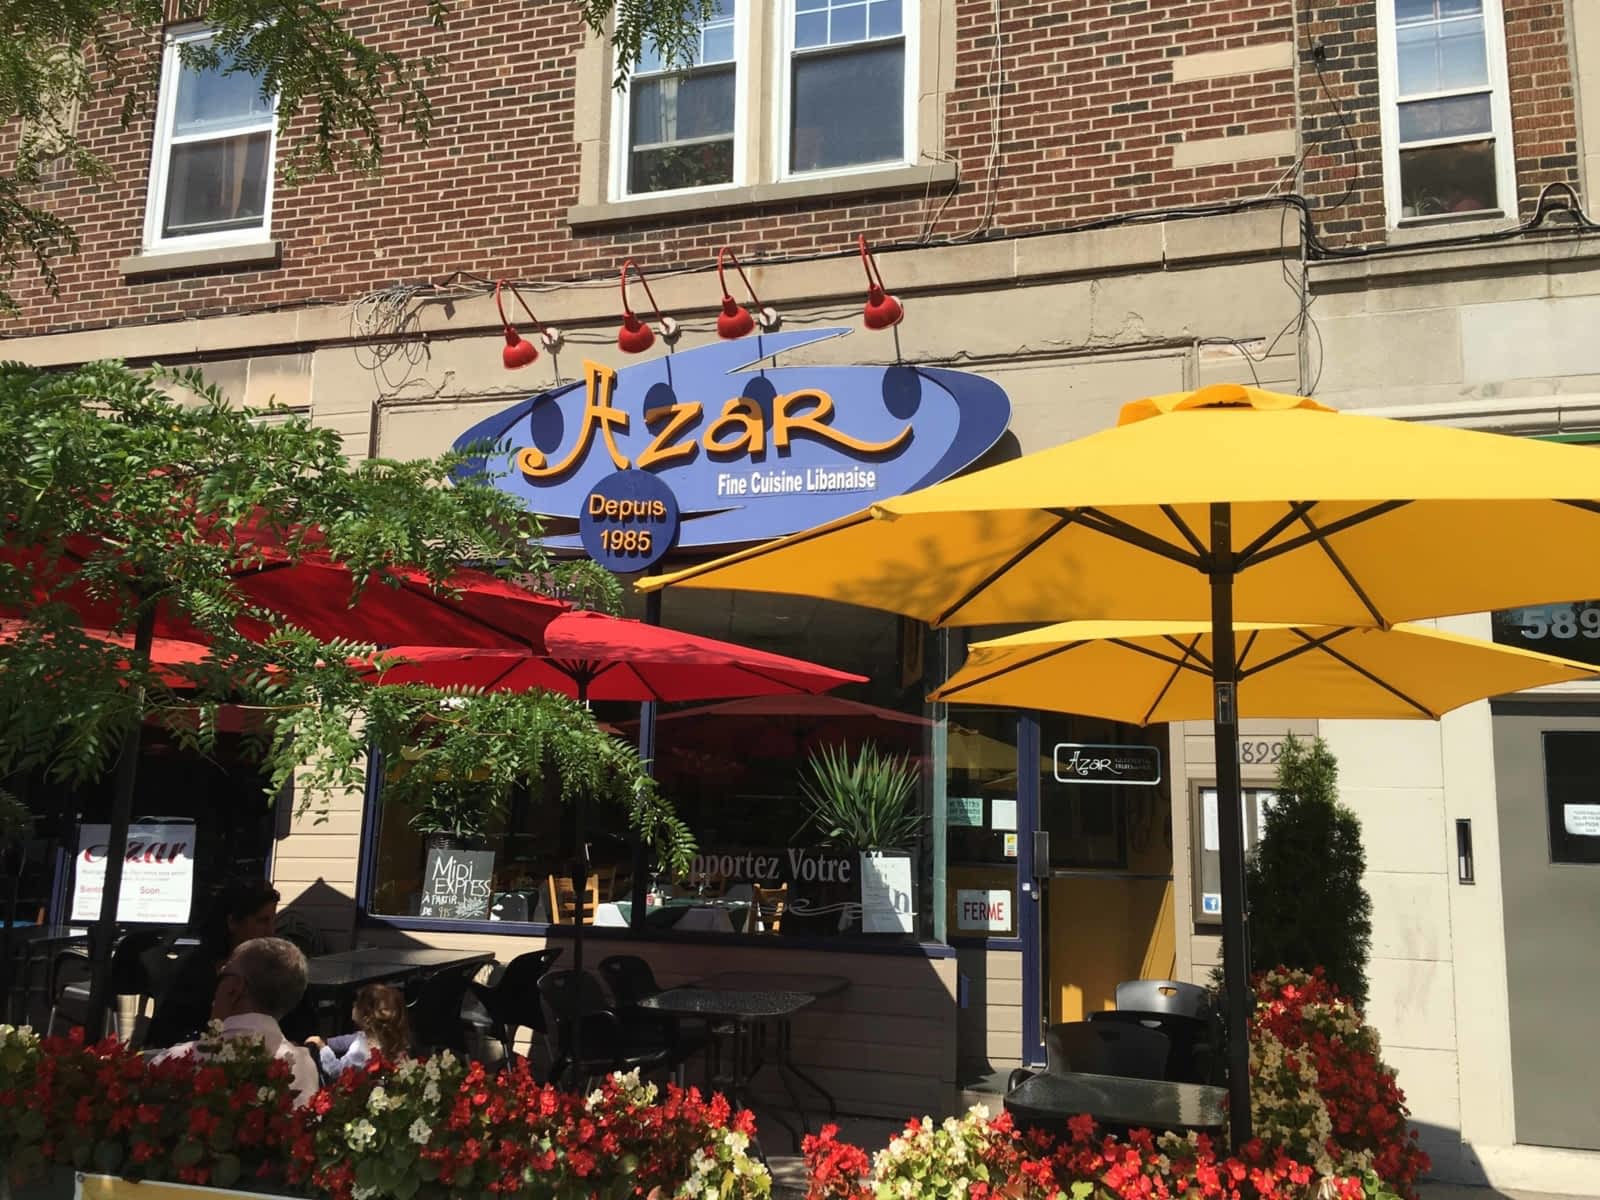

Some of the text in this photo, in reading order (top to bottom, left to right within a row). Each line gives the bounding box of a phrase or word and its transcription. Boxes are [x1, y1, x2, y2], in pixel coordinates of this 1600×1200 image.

[717, 466, 876, 496] Fine Cuisine Libanaise
[589, 494, 667, 520] Depuis
[600, 529, 651, 551] 1985
[84, 841, 187, 865] zar
[690, 848, 850, 888] pportez Votre
[140, 886, 160, 895] Soon
